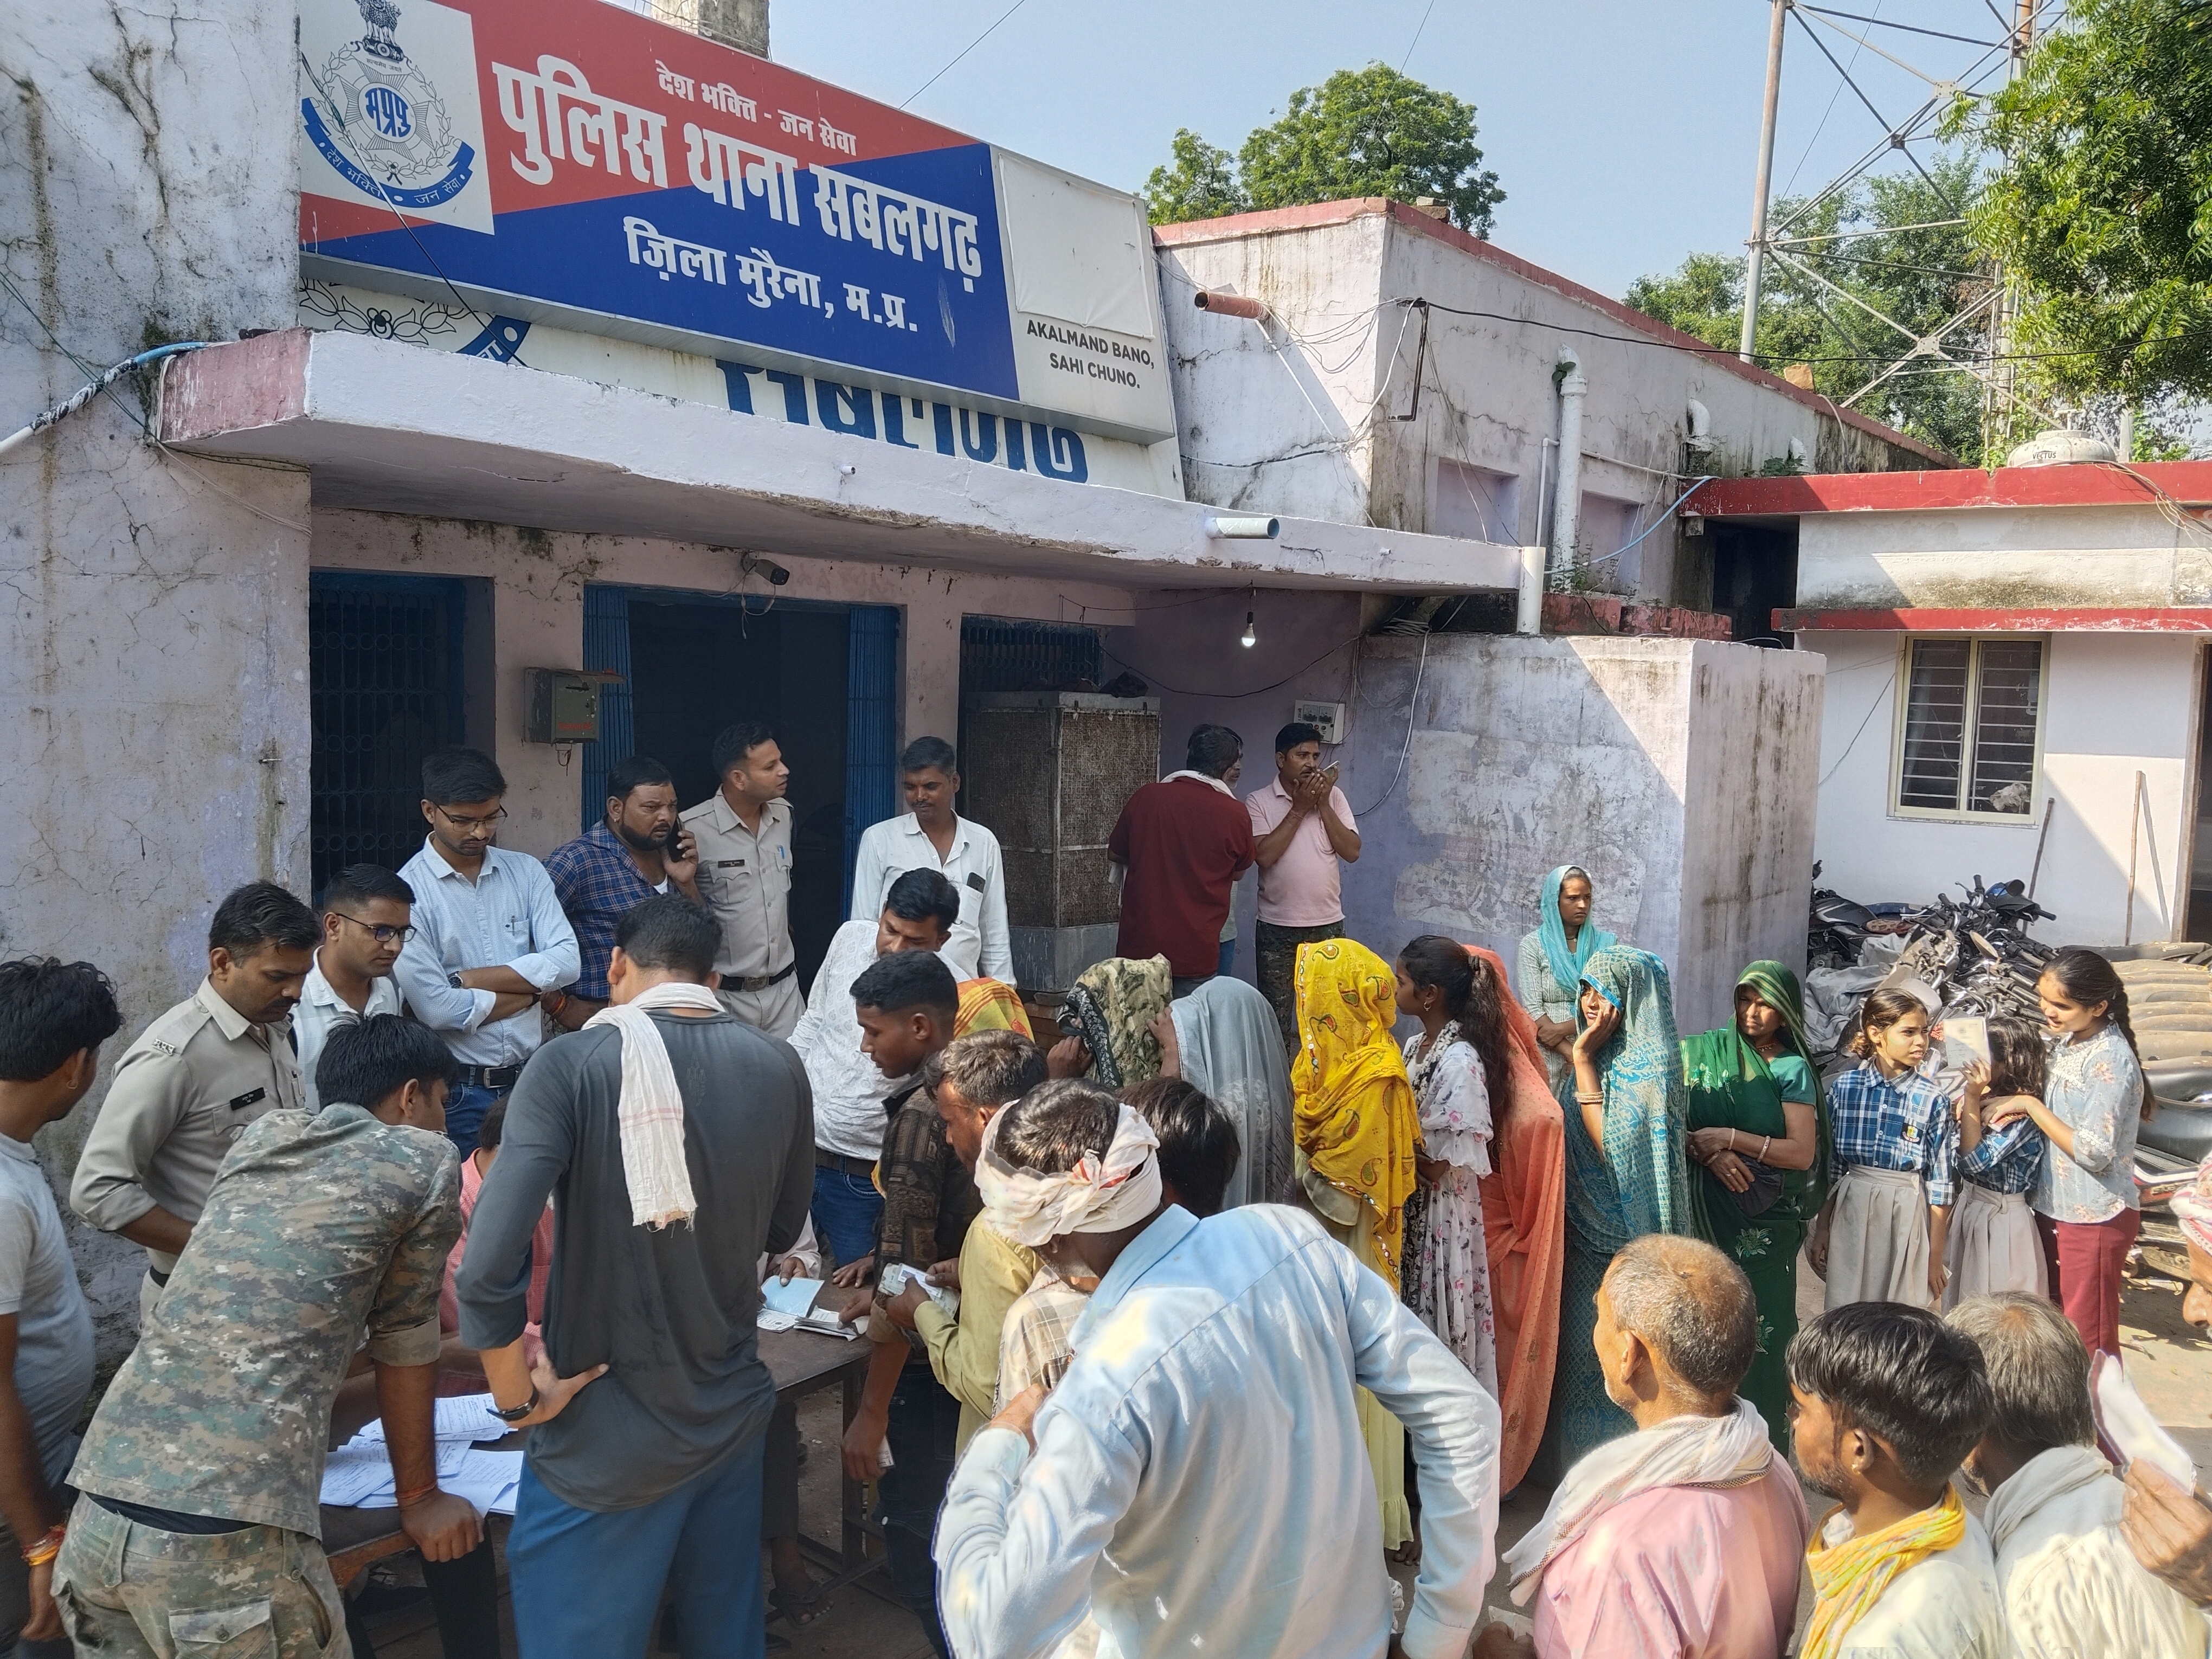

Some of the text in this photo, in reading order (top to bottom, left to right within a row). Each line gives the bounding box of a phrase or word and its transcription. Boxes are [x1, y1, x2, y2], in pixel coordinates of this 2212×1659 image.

[366, 58, 402, 73] सत्यमेव जयते
[655, 59, 695, 102] देश
[700, 82, 757, 123] भक्ति
[777, 109, 814, 142] जन
[818, 117, 857, 157] सेवा
[326, 148, 461, 204] देश भक्ति जन सेवा
[491, 54, 982, 293] पुलिस थाना सबलगढ़
[623, 216, 918, 332] ज़िला मुरैना, म.प्र.
[1026, 319, 1155, 370] AKALMAND BANO,
[1049, 352, 1141, 389] SAHI CHUNO.
[2033, 452, 2056, 460] VECTUS
